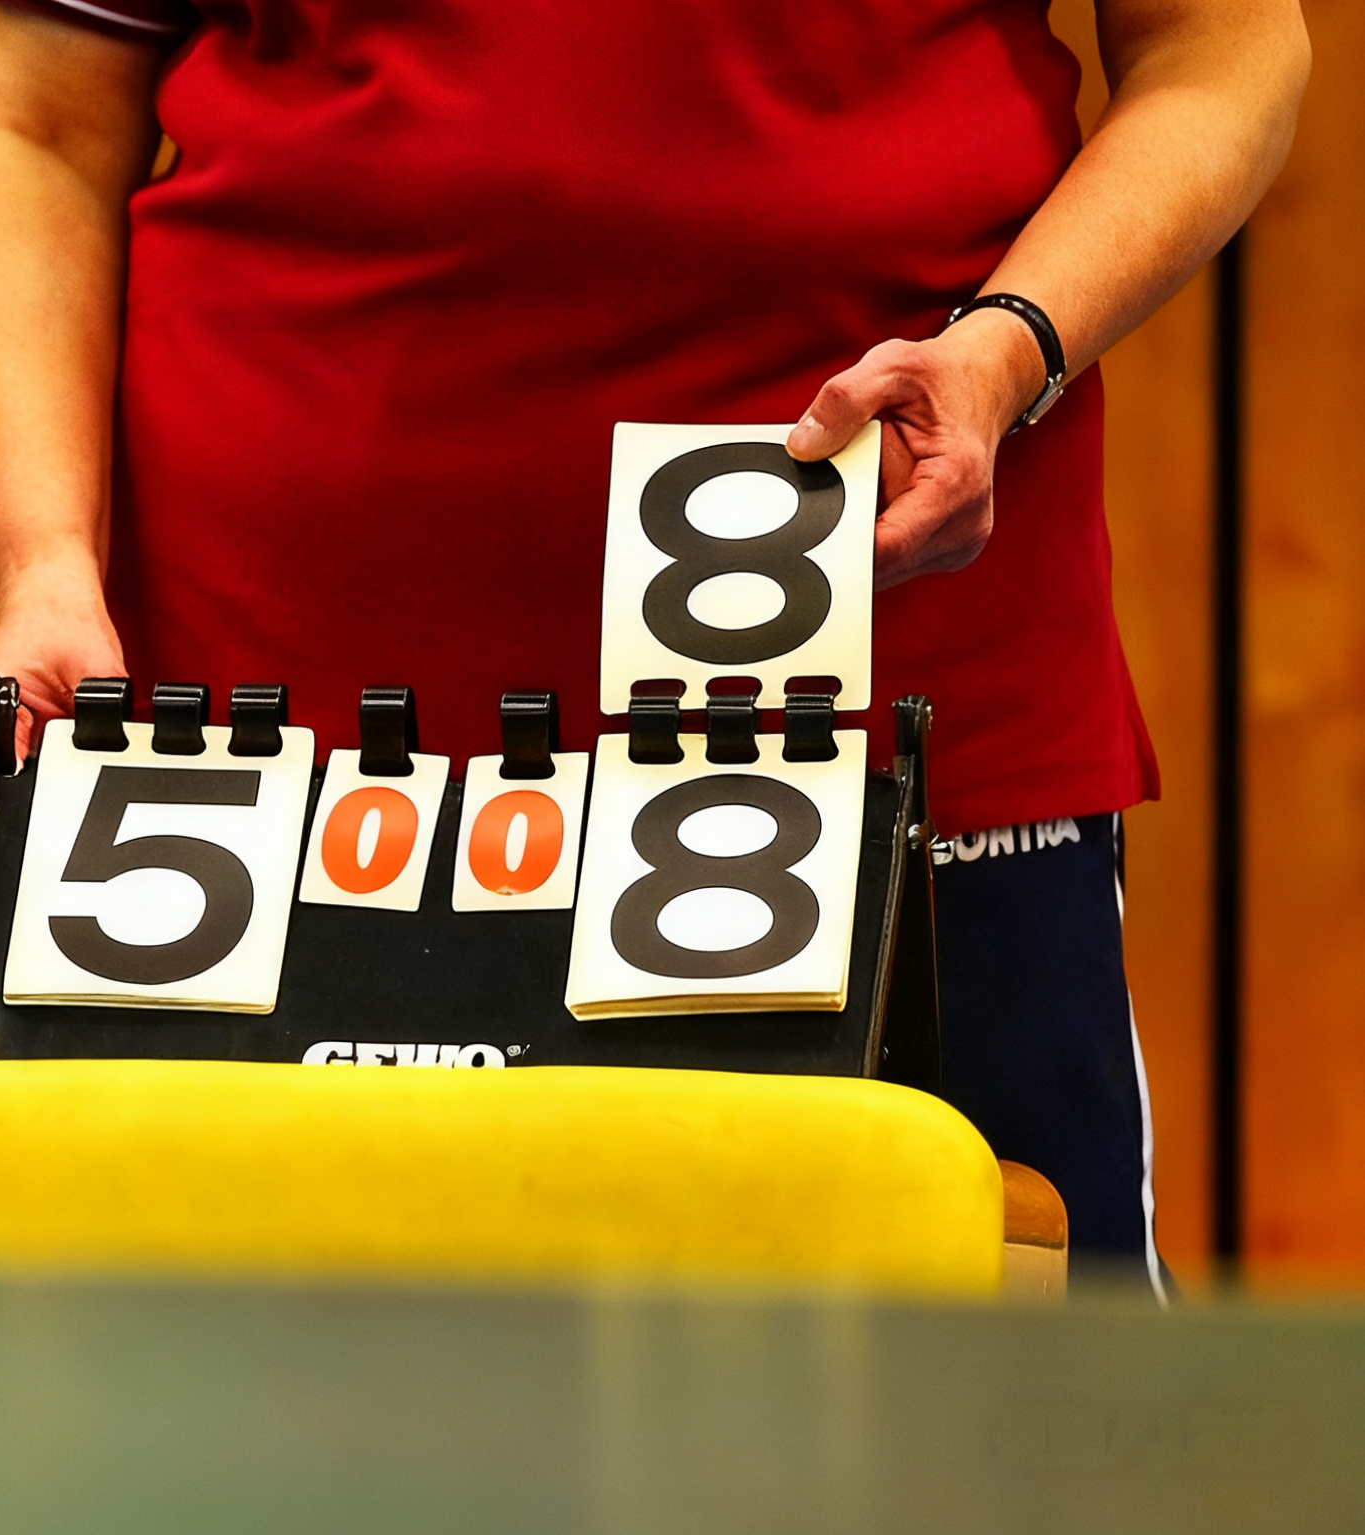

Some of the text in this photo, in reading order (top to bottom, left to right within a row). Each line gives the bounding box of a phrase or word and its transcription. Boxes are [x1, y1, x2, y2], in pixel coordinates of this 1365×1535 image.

[639, 441, 847, 666] 8
[48, 765, 822, 985] 5 0 0 8
